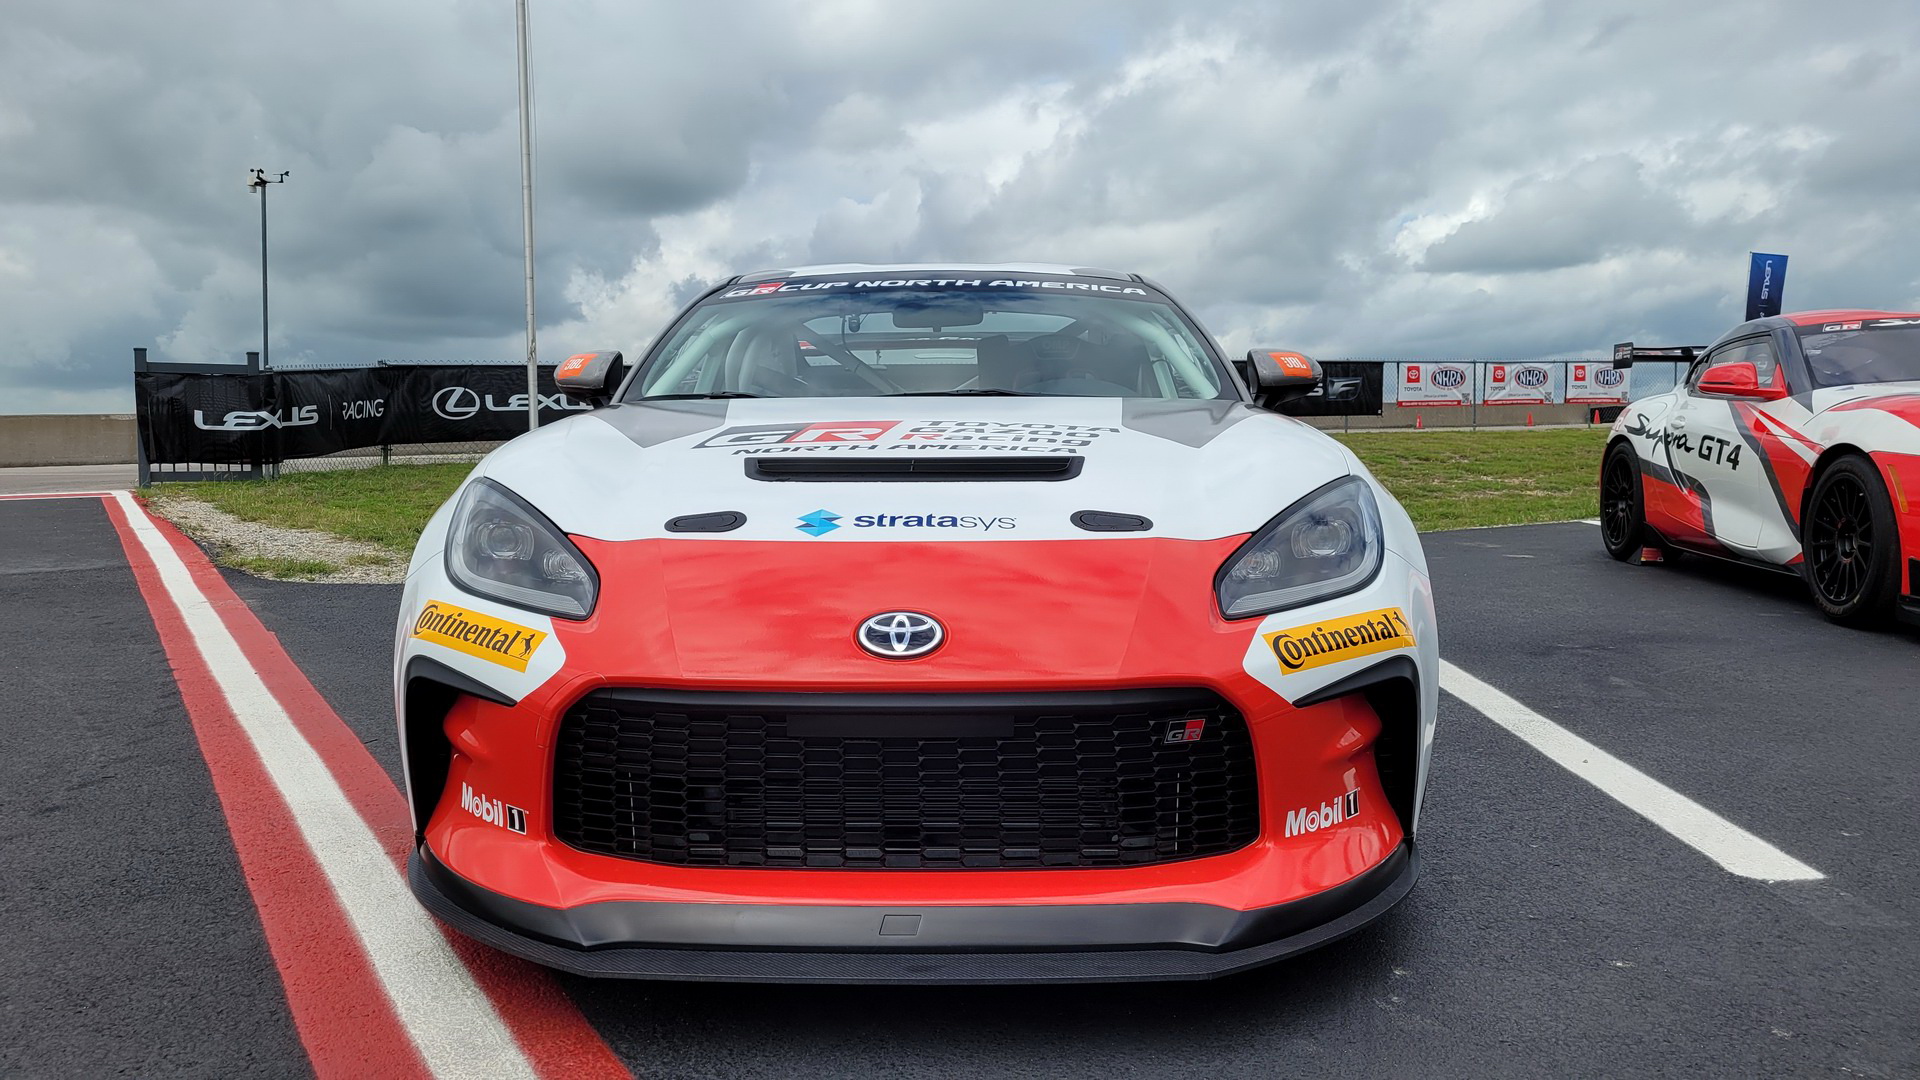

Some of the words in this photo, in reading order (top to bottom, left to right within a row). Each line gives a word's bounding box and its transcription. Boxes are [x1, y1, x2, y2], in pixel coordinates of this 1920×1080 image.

[725, 286, 776, 298] GR
[777, 281, 849, 292] CUP
[854, 279, 981, 288] NORTH
[988, 279, 1147, 296] AMERICA
[1761, 260, 1773, 300] LEXUS
[1824, 323, 1860, 331] GR
[564, 358, 585, 371] JBL
[1281, 356, 1307, 369] JBL
[1435, 370, 1462, 387] NHRA
[1519, 370, 1544, 386] NHRA
[1597, 370, 1620, 385] NHRA
[485, 393, 595, 411] LEXU
[193, 404, 319, 431] LEXUS
[342, 399, 385, 420] RACING
[909, 426, 1100, 438] GAZOO
[919, 420, 1121, 434] TOYOTA
[704, 428, 884, 447] GR
[1624, 413, 1695, 458] Supra
[1698, 434, 1742, 471] GT4
[731, 444, 878, 456] NORTH
[888, 444, 1078, 454] AMERICA
[853, 513, 1017, 532] stratasys
[413, 603, 522, 656] Continental
[1272, 613, 1400, 670] Continental
[1167, 728, 1201, 742] GR
[460, 781, 504, 828] Mobil
[1285, 796, 1343, 838] Mobil
